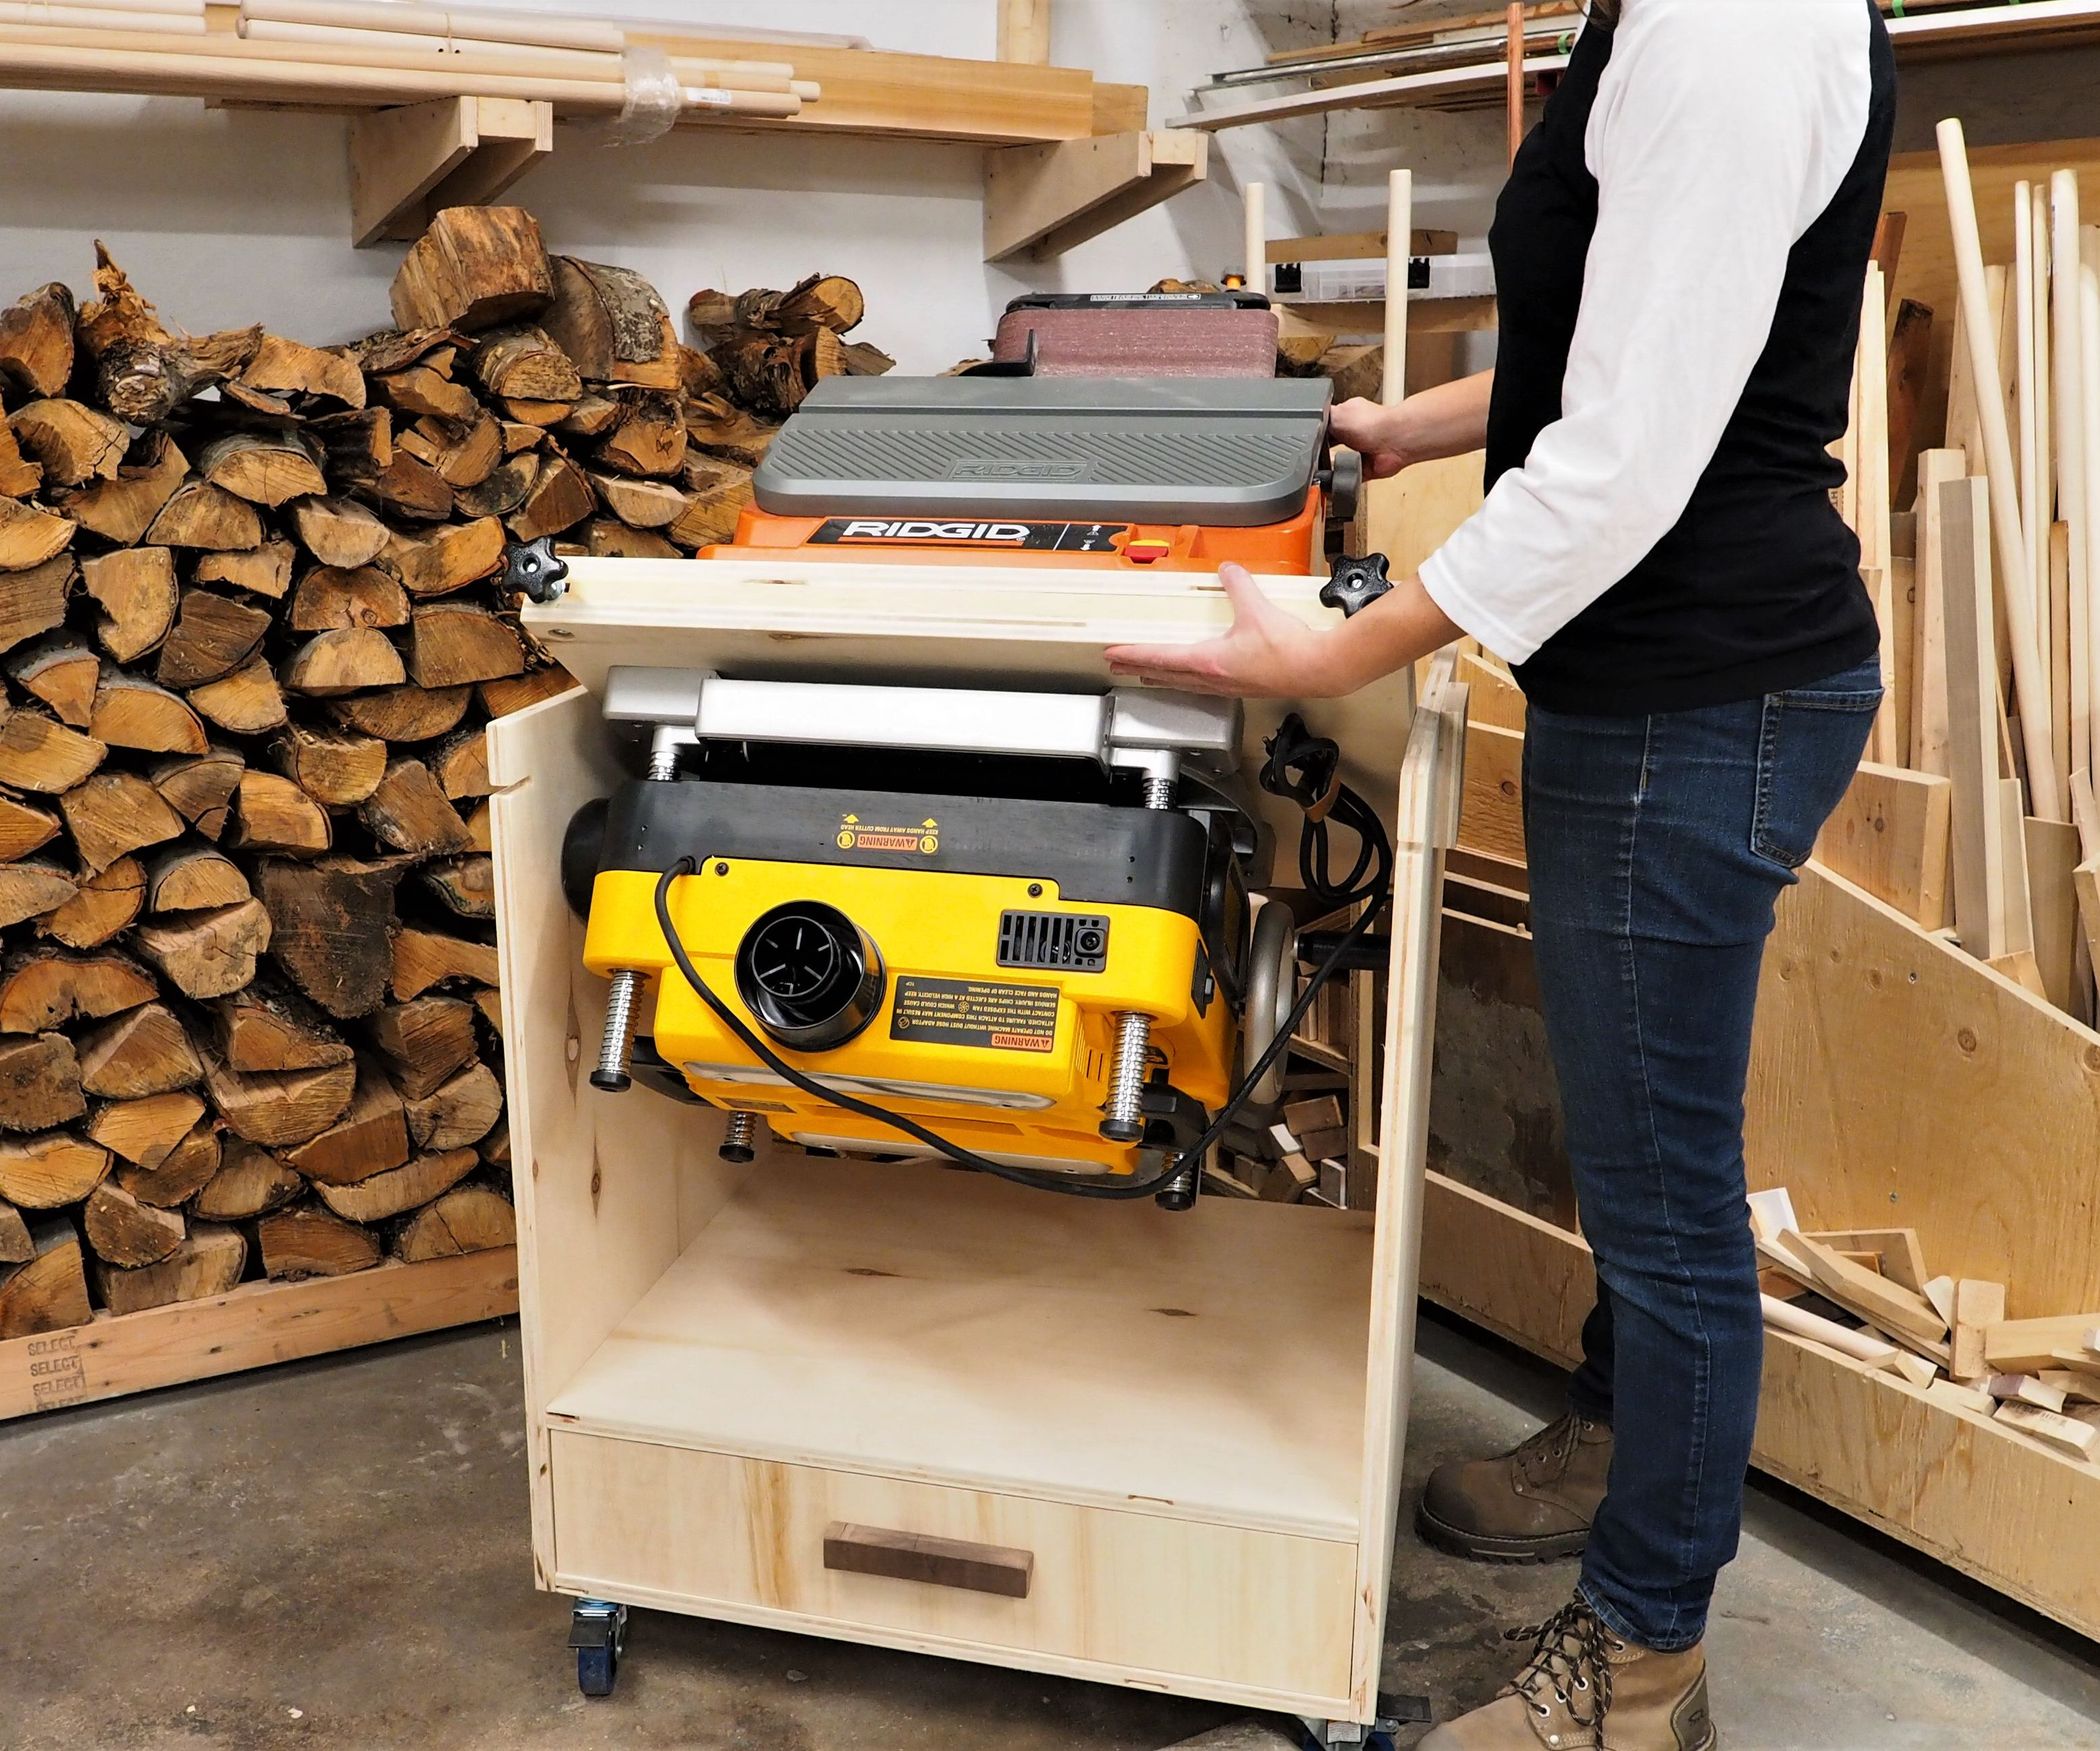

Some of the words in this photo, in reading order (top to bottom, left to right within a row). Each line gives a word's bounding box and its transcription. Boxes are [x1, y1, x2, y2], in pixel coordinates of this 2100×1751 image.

[954, 464, 1081, 477] RIDGID
[843, 522, 1030, 539] RIDGID
[859, 836, 905, 847] WARNING
[994, 1035, 1040, 1048] WARNING
[28, 1336, 75, 1356] SELECT
[31, 1355, 79, 1377] SELECT
[33, 1376, 81, 1397] SELECT
